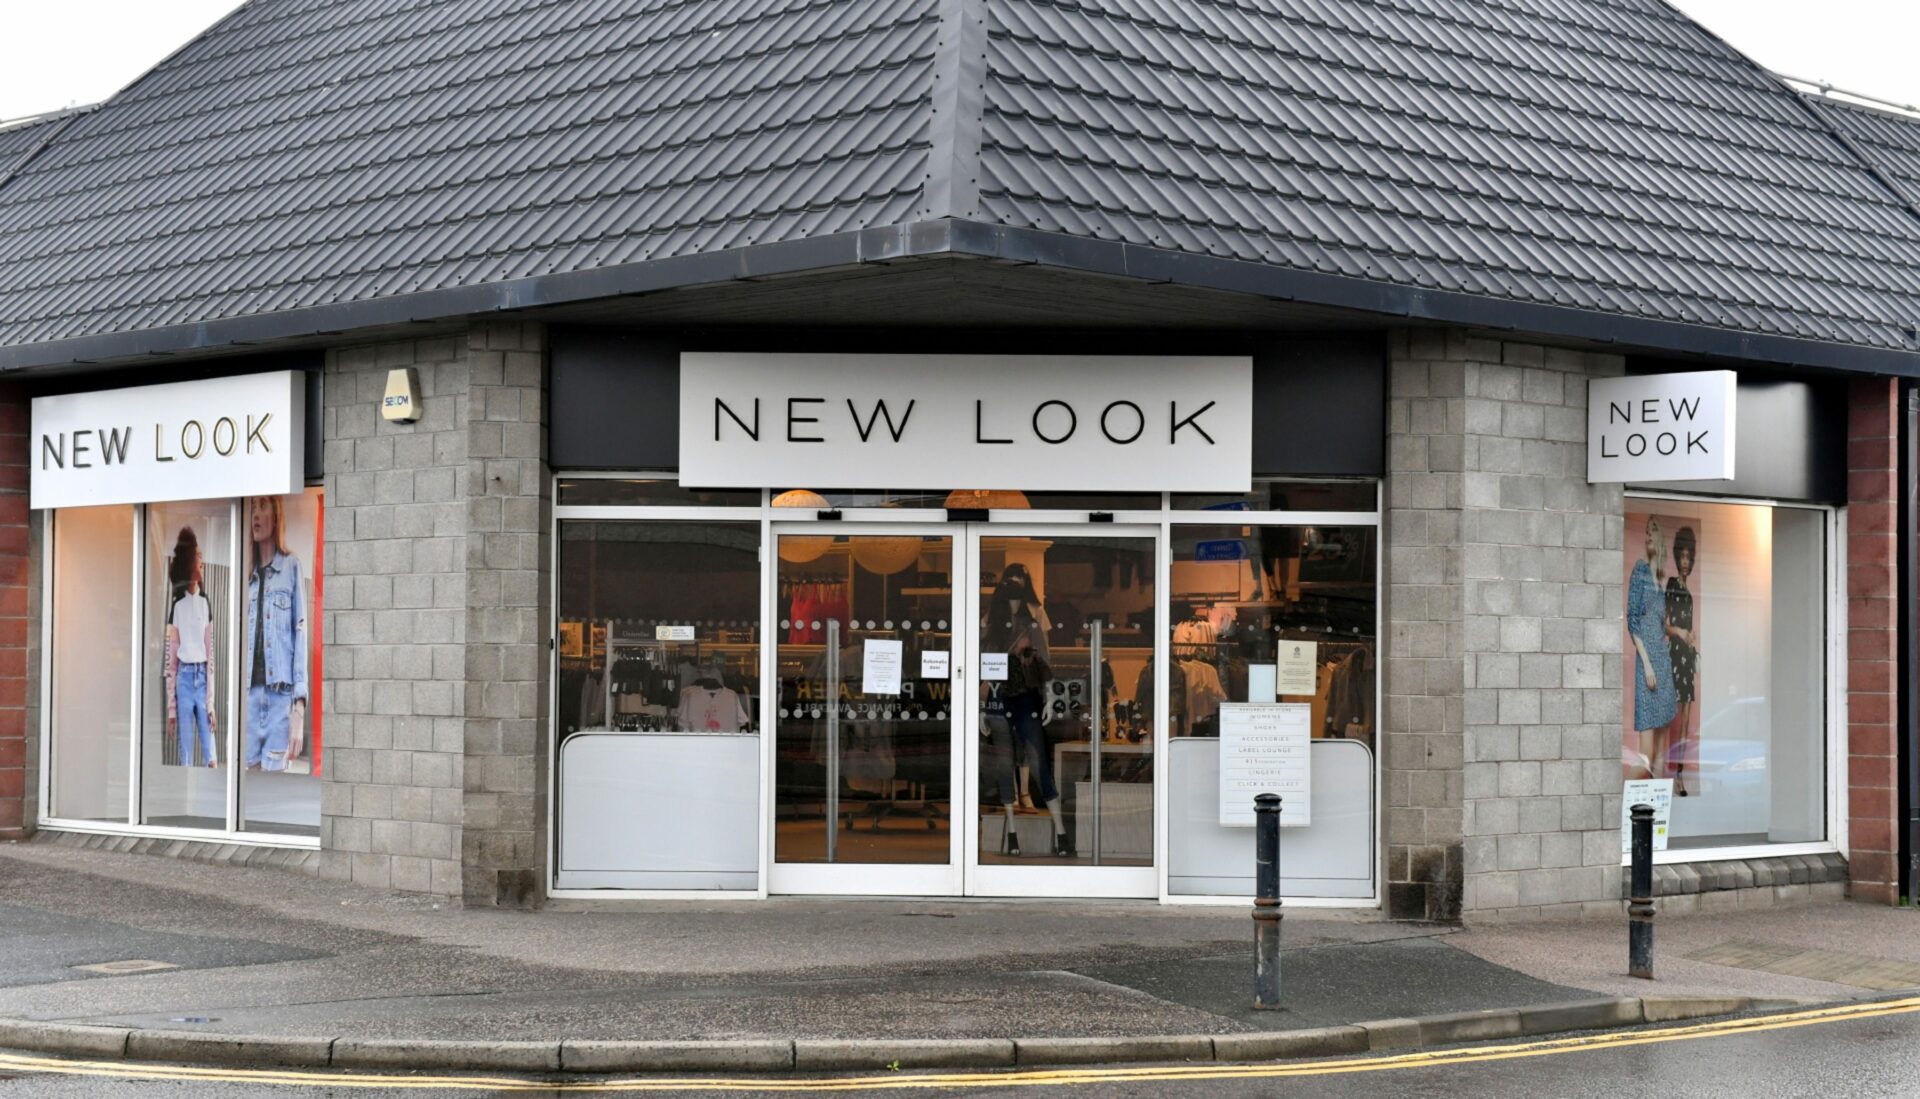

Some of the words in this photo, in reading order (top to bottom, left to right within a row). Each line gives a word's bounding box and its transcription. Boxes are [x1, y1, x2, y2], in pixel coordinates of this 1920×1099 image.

[714, 397, 915, 442] NEW
[976, 399, 1216, 445] LOOK
[1610, 396, 1701, 424] NEW
[43, 426, 132, 471] NEW
[156, 412, 273, 462] LOOK
[1601, 430, 1709, 458] LOOK
